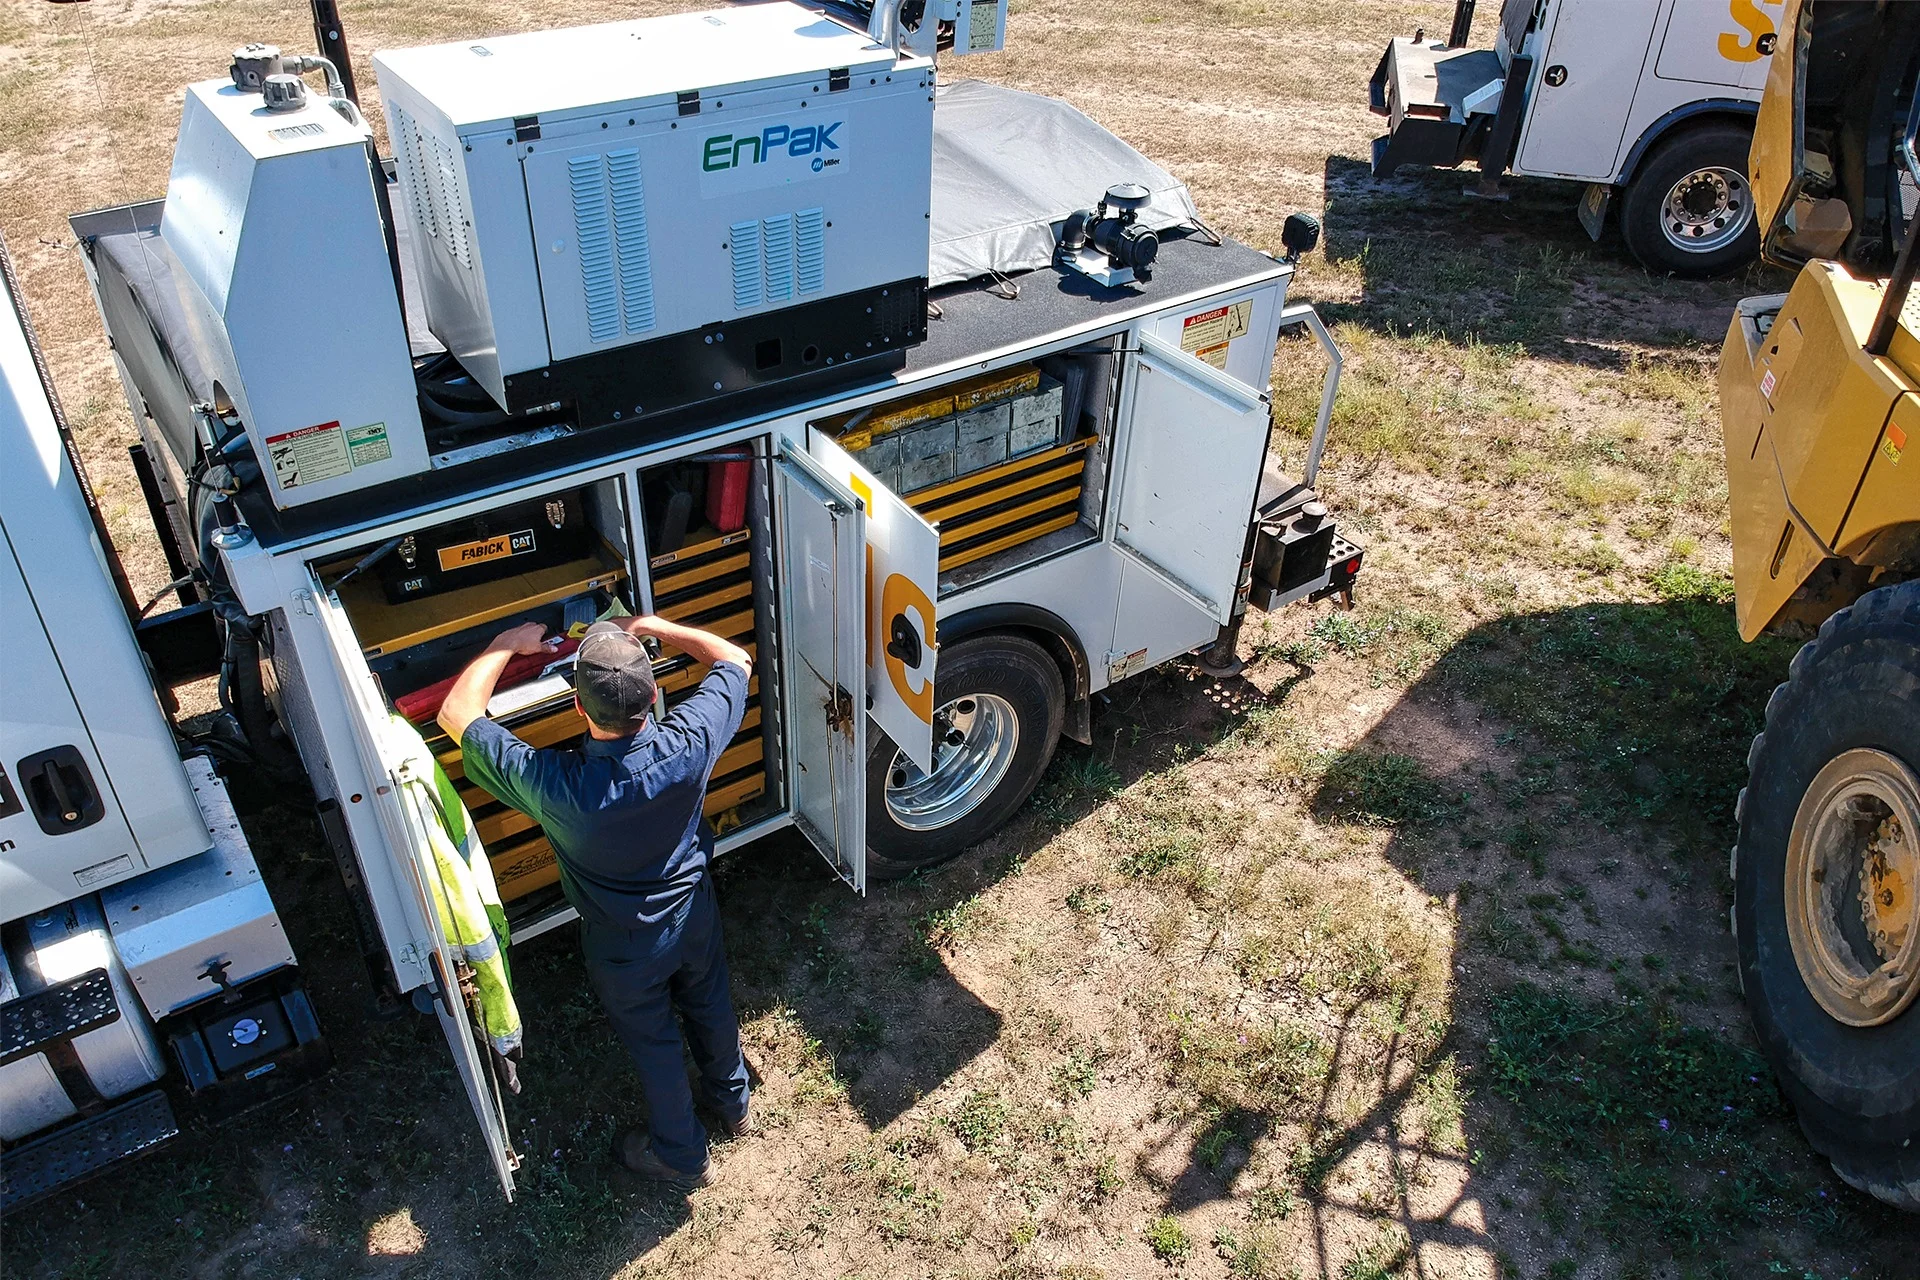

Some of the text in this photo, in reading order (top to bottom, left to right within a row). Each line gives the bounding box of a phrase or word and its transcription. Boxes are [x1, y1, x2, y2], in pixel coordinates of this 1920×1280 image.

[702, 121, 843, 173] EnPak
[823, 158, 841, 168] Miller
[1196, 309, 1223, 323] DANGER
[292, 426, 320, 438] DANGER
[511, 534, 531, 549] CAT
[461, 541, 505, 561] FABICK
[404, 578, 423, 592] CAT
